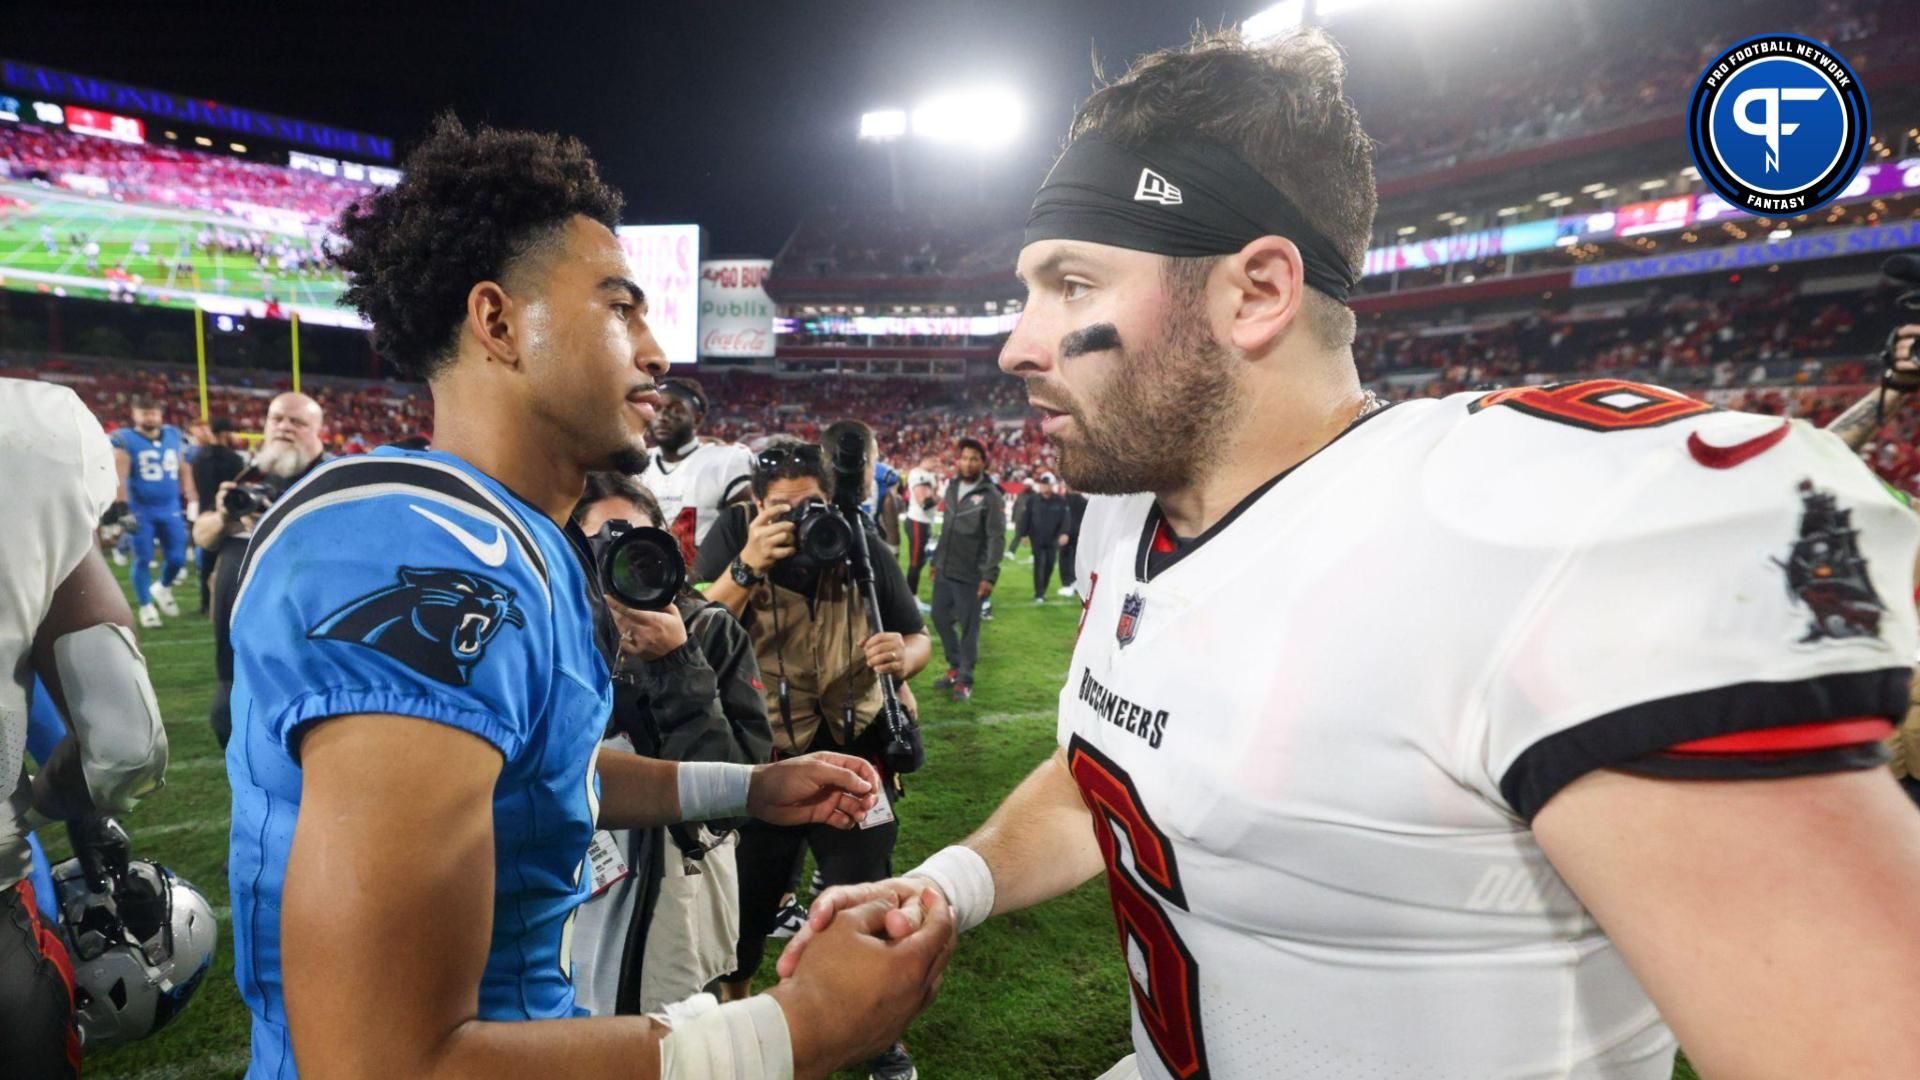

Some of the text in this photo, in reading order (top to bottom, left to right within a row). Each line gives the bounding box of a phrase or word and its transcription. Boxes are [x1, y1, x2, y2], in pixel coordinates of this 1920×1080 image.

[720, 266, 738, 288] GO
[701, 301, 767, 317] Publix
[138, 449, 179, 482] 64
[1078, 666, 1170, 750] BUCCANEERS
[1067, 732, 1212, 1080] 6
